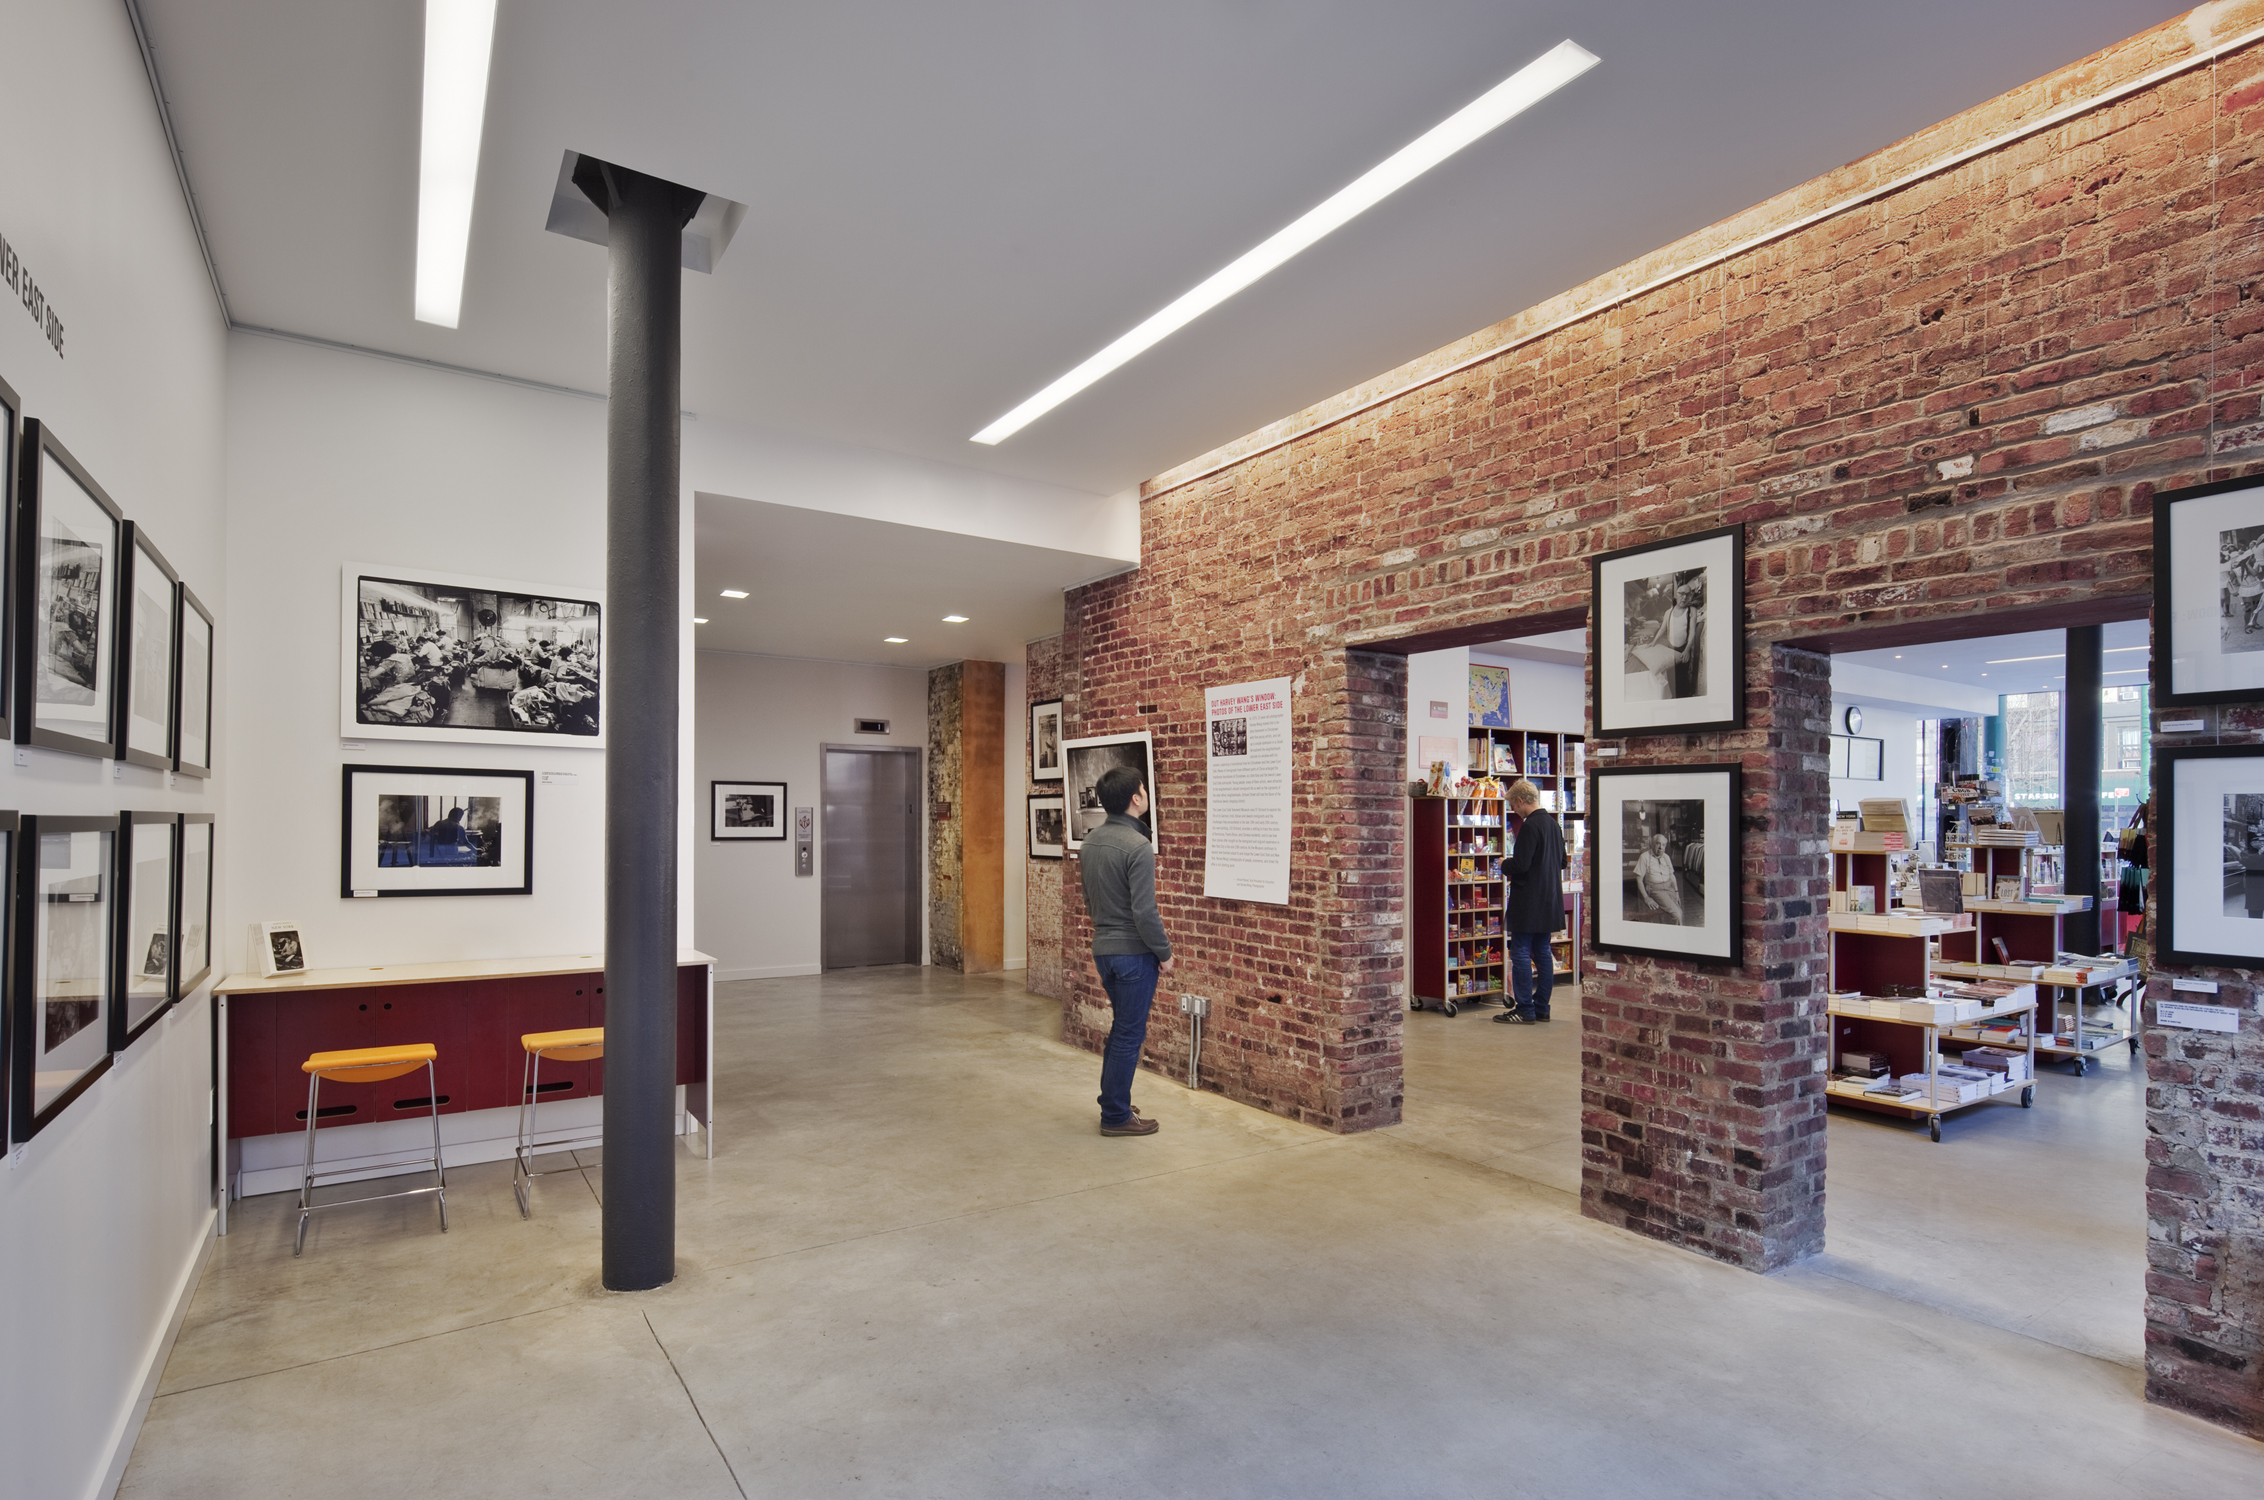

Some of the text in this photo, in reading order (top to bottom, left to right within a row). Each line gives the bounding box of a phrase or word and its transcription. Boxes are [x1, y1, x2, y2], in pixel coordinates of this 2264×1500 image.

[22, 266, 45, 330] EAST
[46, 304, 64, 361] SIDE
[1211, 692, 1277, 708] OUT HARVEY WANG'S WINDOW:
[1211, 700, 1284, 716] PHOTOS OF THE LOWER EAST SIDE
[2000, 888, 2013, 898] LOST
